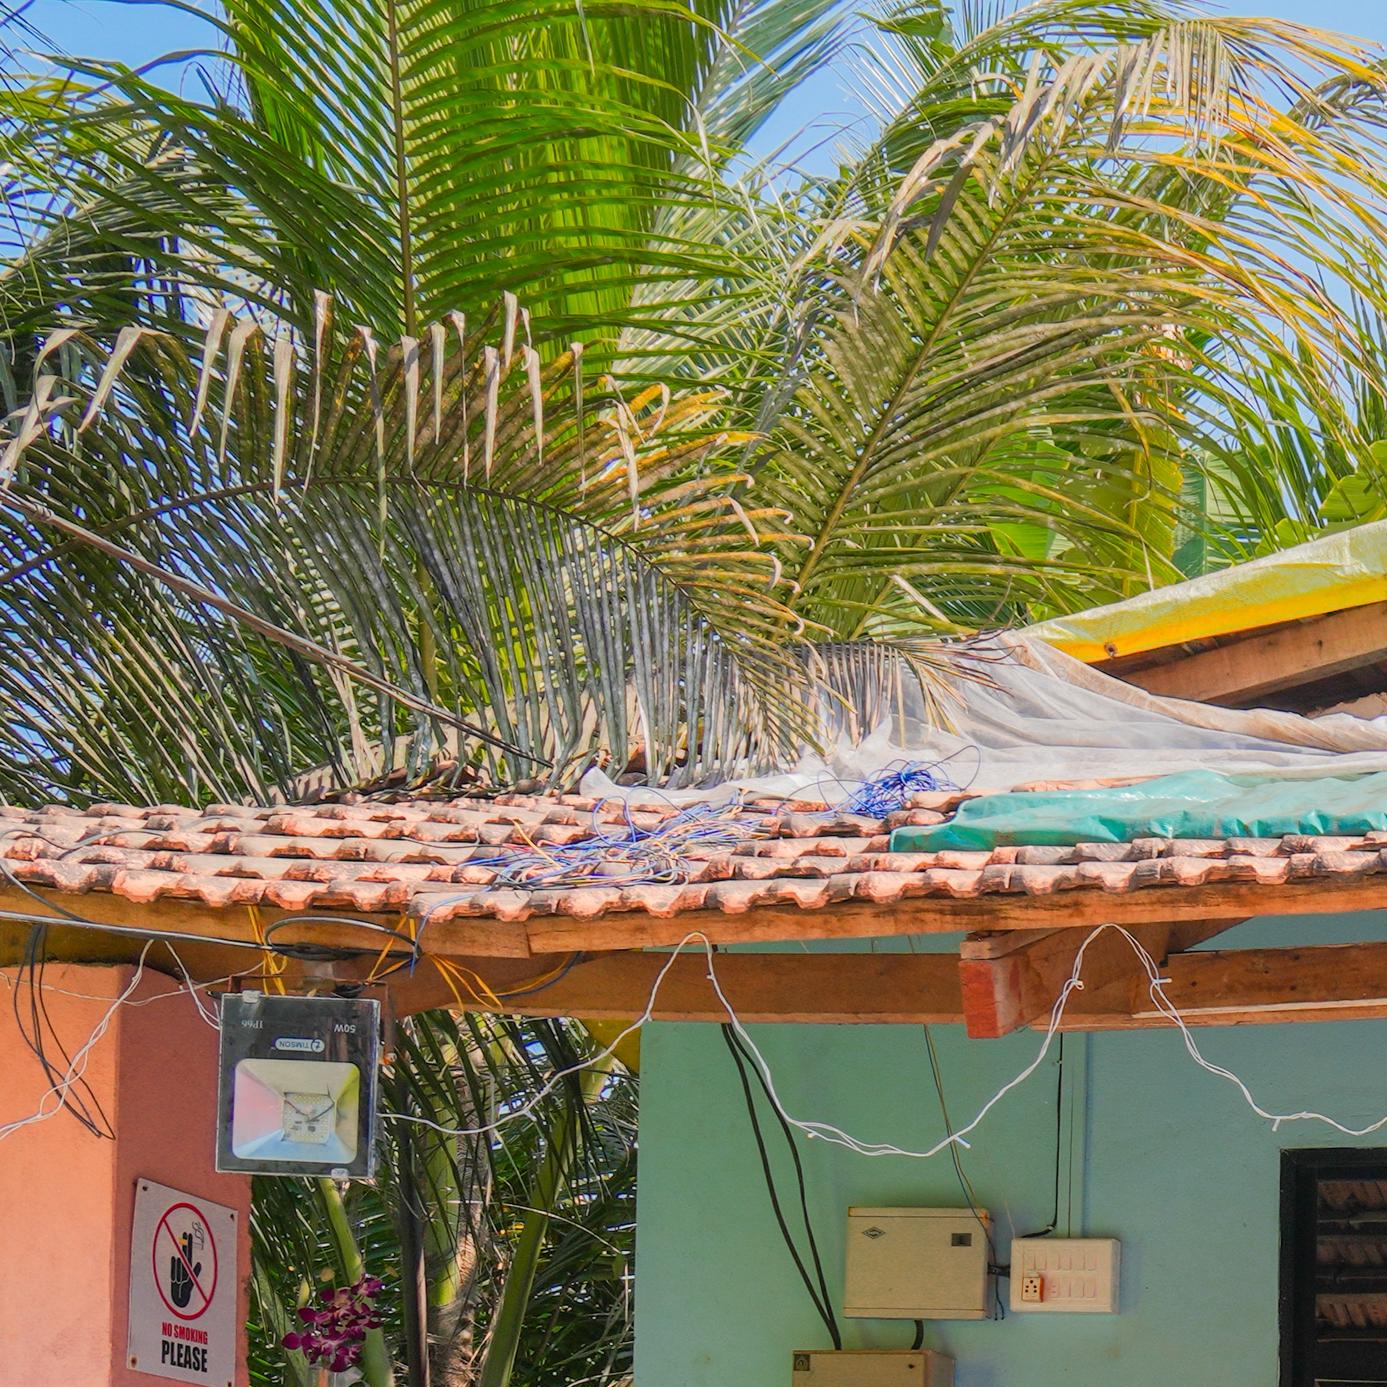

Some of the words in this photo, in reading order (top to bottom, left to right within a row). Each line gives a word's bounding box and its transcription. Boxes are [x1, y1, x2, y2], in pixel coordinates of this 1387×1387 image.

[333, 1023, 356, 1034] 50W
[278, 1040, 310, 1050] TIMSON
[161, 1322, 173, 1337] NO
[174, 1325, 208, 1345] SMOKING
[161, 1340, 208, 1373] PLEASE
